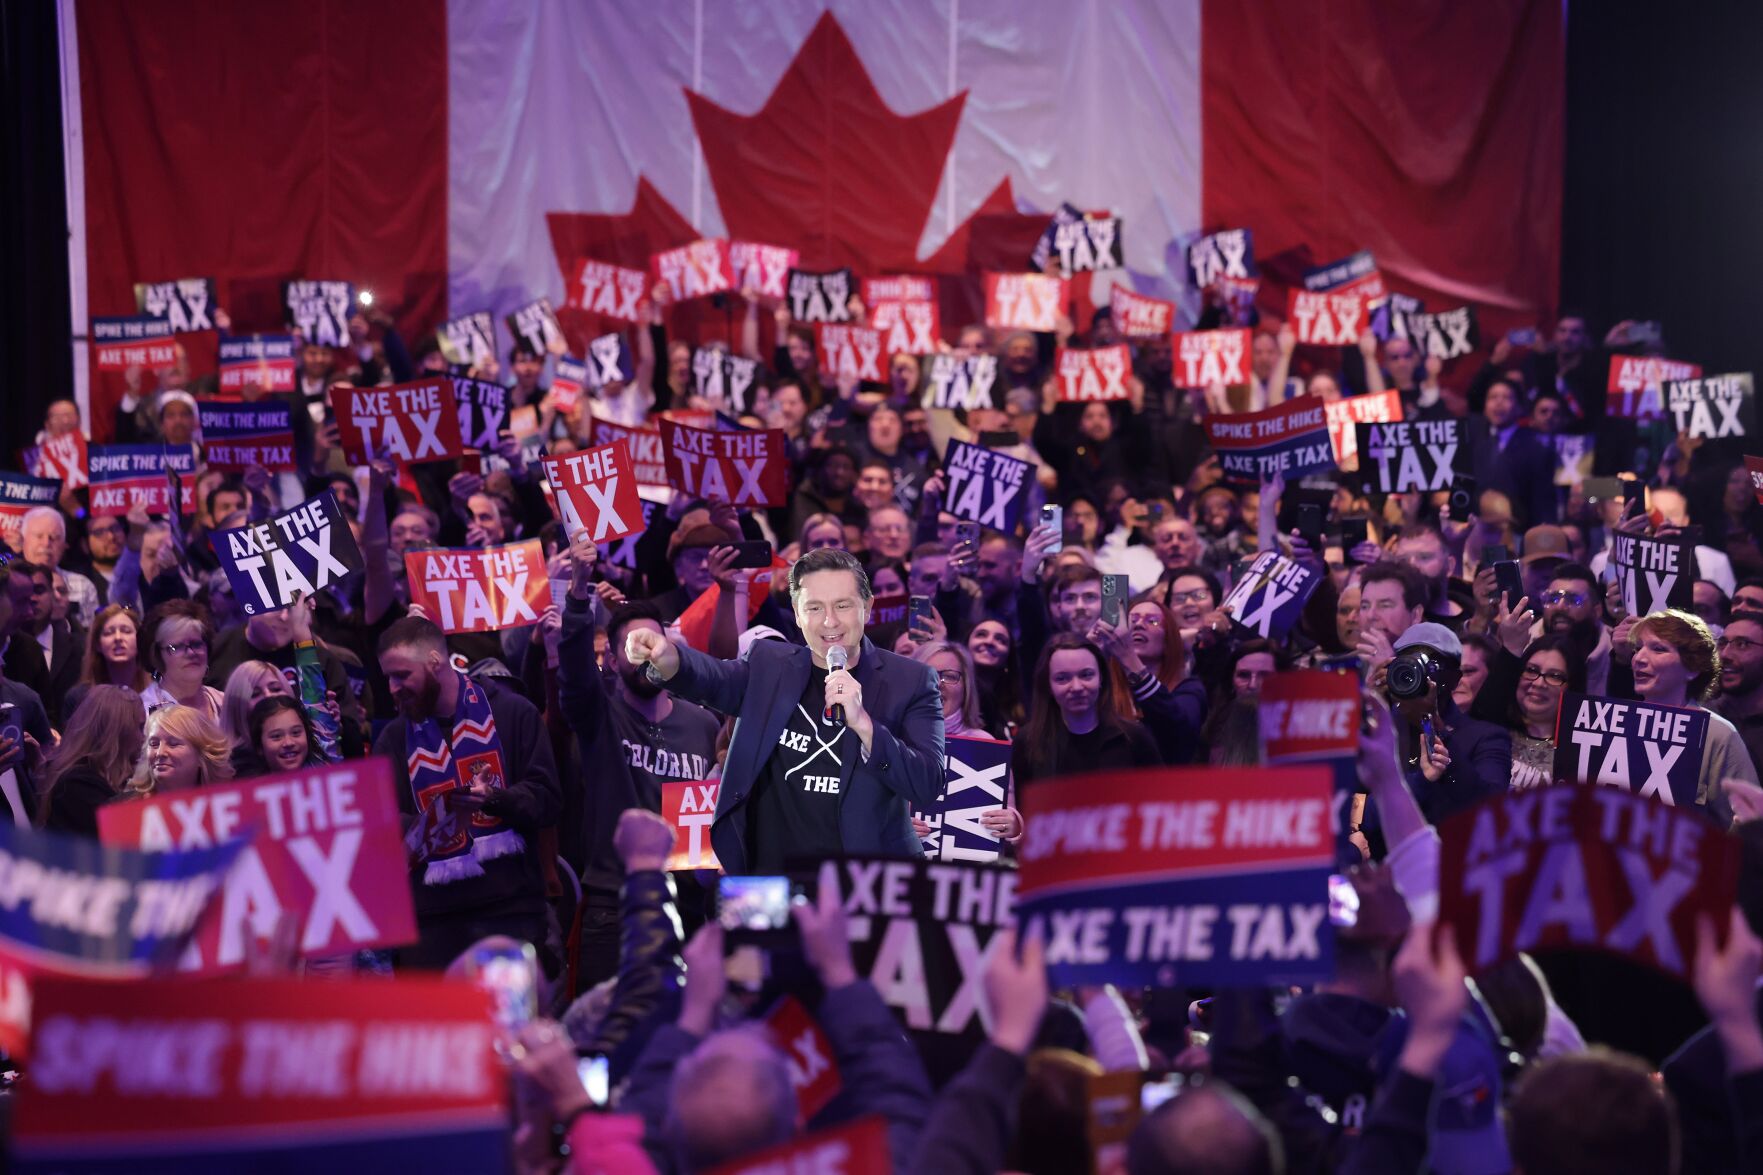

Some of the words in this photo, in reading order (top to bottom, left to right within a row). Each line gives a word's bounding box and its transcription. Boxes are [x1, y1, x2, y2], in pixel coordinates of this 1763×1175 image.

[1054, 236, 1117, 274] TAX
[1190, 247, 1248, 288] TAX
[581, 275, 642, 322] TAX
[662, 258, 730, 300] TAX
[146, 297, 212, 332] TAX
[790, 289, 849, 322] TAX
[995, 292, 1059, 330] TAX
[873, 317, 933, 355] TAX
[1293, 309, 1362, 345] TAX
[1410, 323, 1472, 360] TAX
[823, 342, 881, 381] TAX
[1179, 349, 1244, 387] TAX
[1619, 358, 1652, 381] AXE
[351, 391, 392, 416] AXE
[395, 385, 441, 413] THE
[477, 382, 506, 410] THE
[930, 369, 998, 411] TAX
[1059, 364, 1127, 400] TAX
[1617, 379, 1662, 417] TA
[1668, 381, 1703, 402] AXE
[1705, 376, 1742, 400] THE
[202, 412, 232, 429] SPIKE
[234, 411, 256, 429] THE
[352, 409, 448, 465] TAX
[456, 402, 506, 449] AX
[1212, 422, 1253, 439] SPIKE
[1256, 416, 1285, 437] THE
[1288, 406, 1324, 429] HIKE
[1369, 424, 1410, 447] AXE
[1415, 419, 1459, 444] THE
[1668, 398, 1746, 439] TAX
[208, 446, 233, 465] AXE
[235, 446, 258, 464] THE
[262, 446, 292, 465] TAX
[673, 426, 714, 457] AXE
[721, 433, 768, 458] THE
[1224, 453, 1255, 474] AXE
[1257, 450, 1291, 474] THE
[1294, 442, 1330, 466] TAX
[90, 455, 130, 473] SPIKE
[133, 454, 156, 471] THE
[564, 447, 619, 486] THE
[673, 447, 769, 504] TAX
[950, 442, 991, 474] AXE
[991, 454, 1029, 487] THE
[1369, 443, 1459, 493] TAX
[93, 489, 126, 508] AXE
[129, 486, 158, 506] THE
[161, 487, 192, 504] TX
[556, 476, 629, 542] AX
[945, 464, 1020, 531] TAX
[227, 523, 278, 559] AXE
[274, 499, 330, 543] THE
[234, 524, 350, 609] TAX
[425, 554, 475, 580] AXE
[477, 548, 529, 578] THE
[1617, 535, 1636, 567] AXE
[1639, 540, 1681, 573] THE
[1267, 555, 1311, 595] THE
[1617, 564, 1679, 618] TAX
[425, 571, 539, 631] TAX
[1289, 699, 1357, 738] HIKE
[1573, 699, 1629, 735] AXE
[1635, 707, 1692, 744] THE
[803, 775, 841, 794] THE
[1572, 730, 1686, 807] TAX
[139, 792, 242, 853] AXE
[254, 770, 364, 841] THE
[680, 785, 720, 813] AX
[941, 755, 1007, 863] TAX
[1023, 803, 1131, 860] SPIKE
[1138, 800, 1219, 850] THE
[1222, 797, 1325, 847] HIKE
[1464, 786, 1577, 866] AXE
[1593, 789, 1706, 877] THE
[205, 829, 380, 968] AX
[844, 860, 916, 915] XE
[926, 865, 1019, 926] THE
[1463, 840, 1698, 974] TAX
[1046, 906, 1115, 965] XE
[1123, 904, 1220, 963] THE
[1226, 902, 1328, 960] TAX
[848, 914, 1005, 1036] AX
